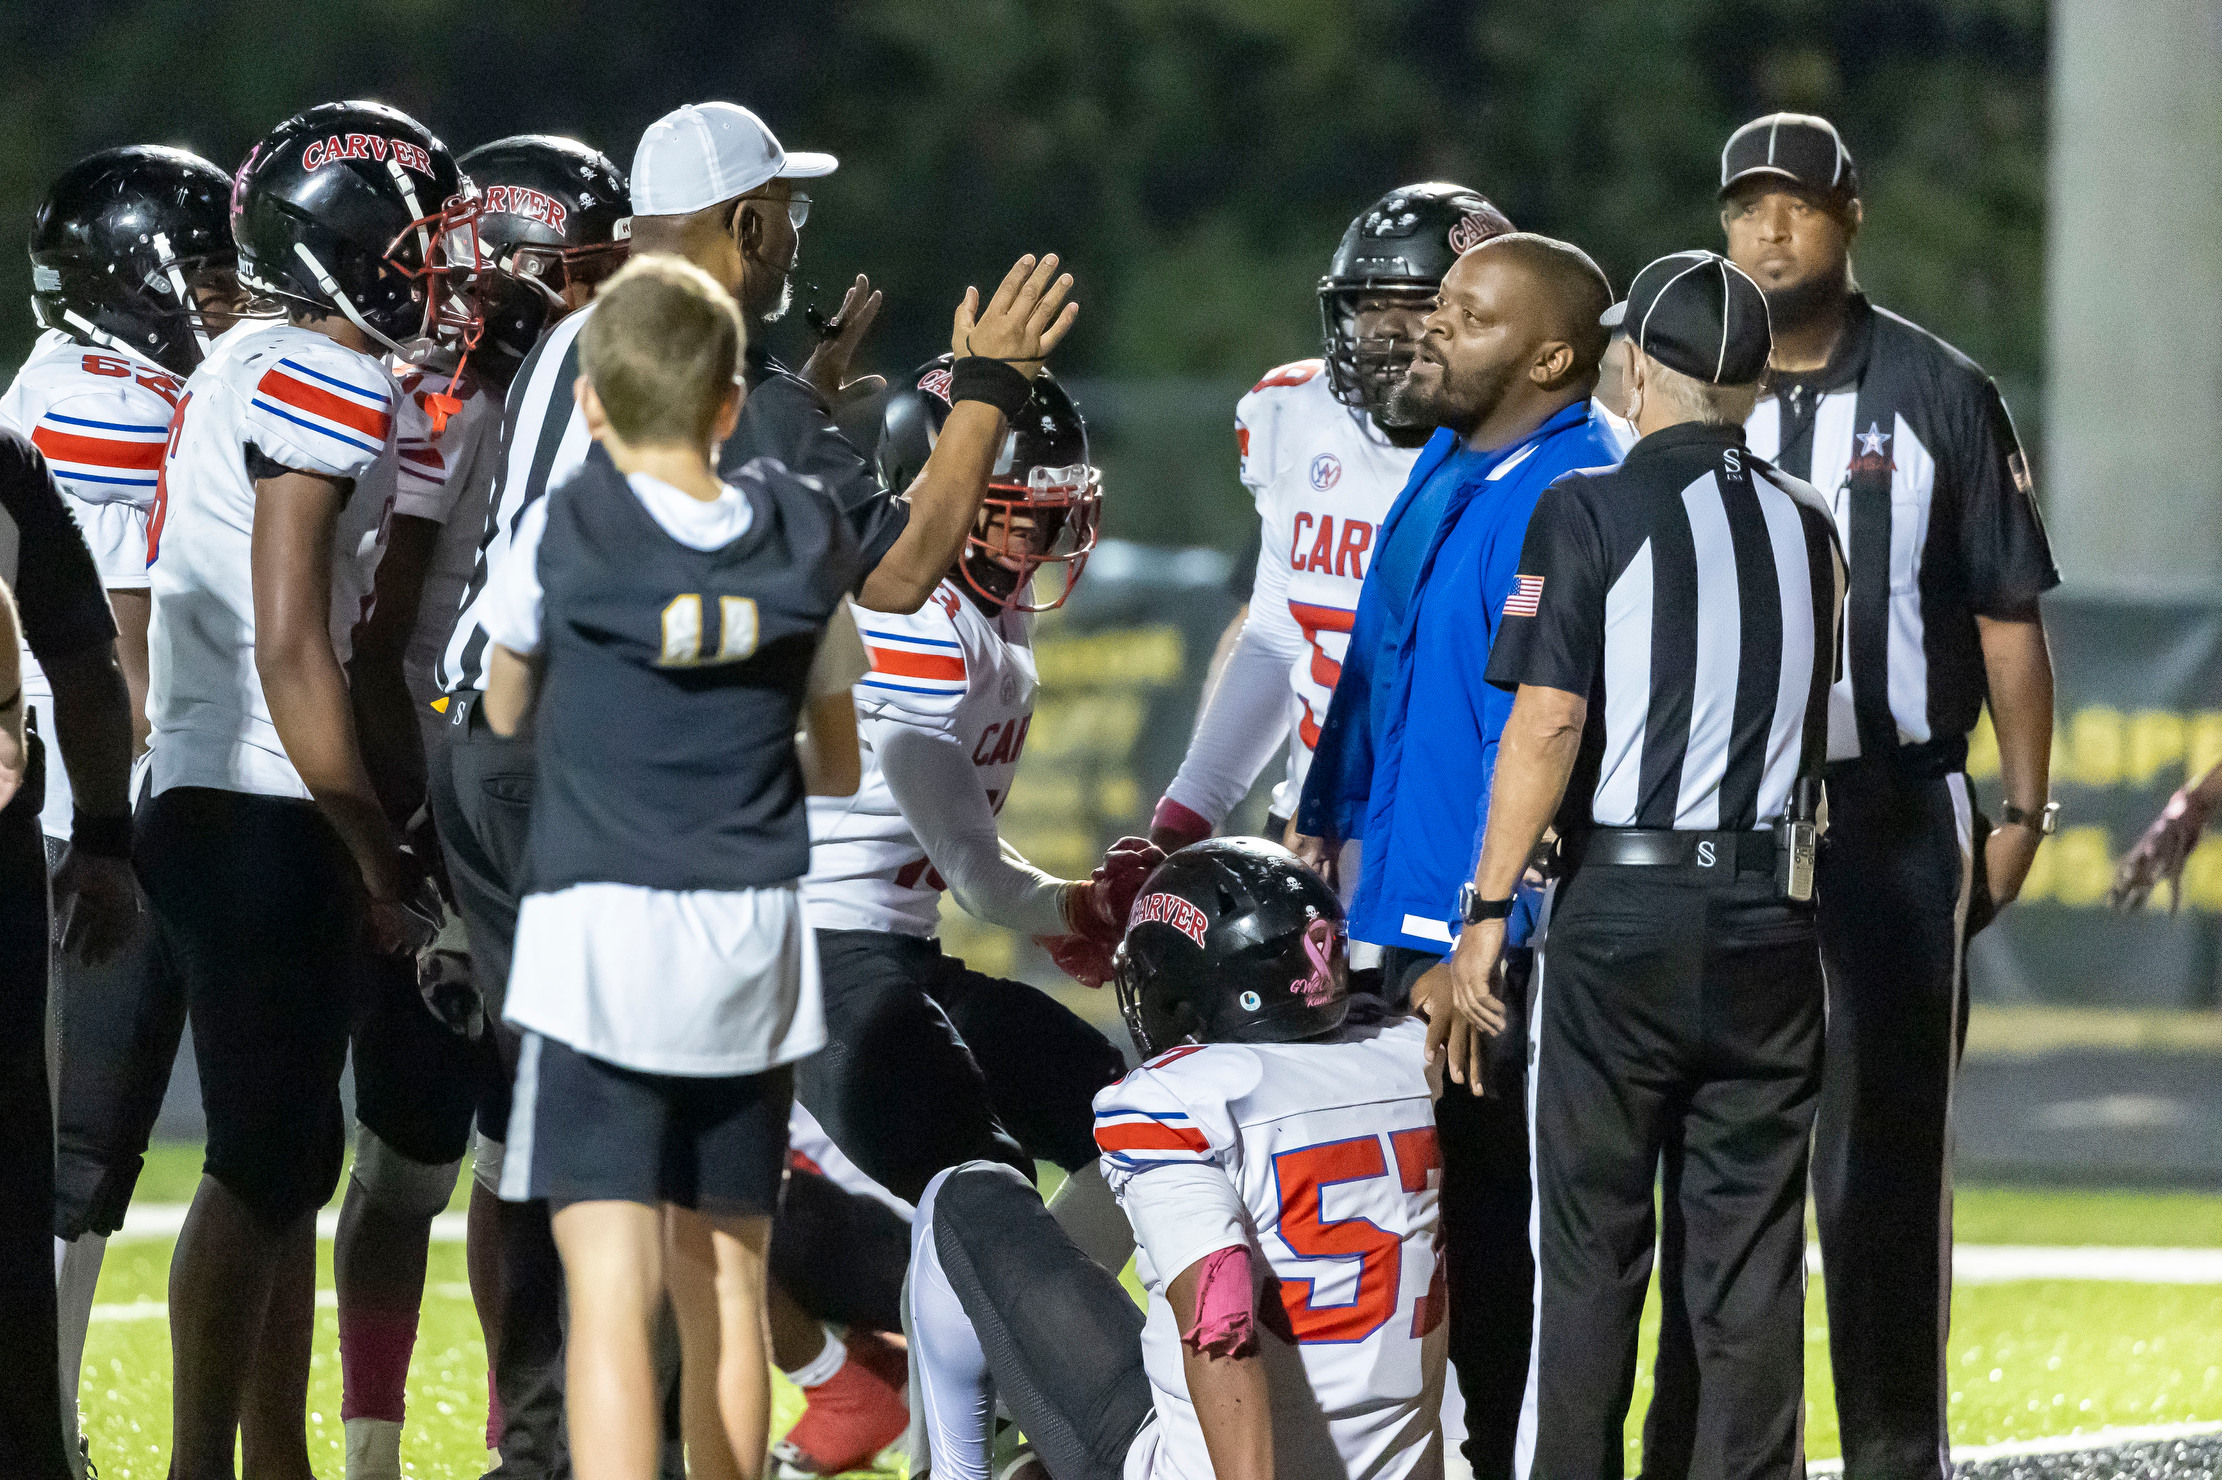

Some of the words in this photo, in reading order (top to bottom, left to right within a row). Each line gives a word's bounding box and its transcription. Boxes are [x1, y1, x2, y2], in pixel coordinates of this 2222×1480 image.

[303, 133, 437, 181] CARVER
[484, 185, 567, 237] RVER
[1723, 448, 1741, 473] S
[1291, 511, 1382, 580] CAR
[451, 701, 466, 725] S
[1697, 841, 1716, 867] S
